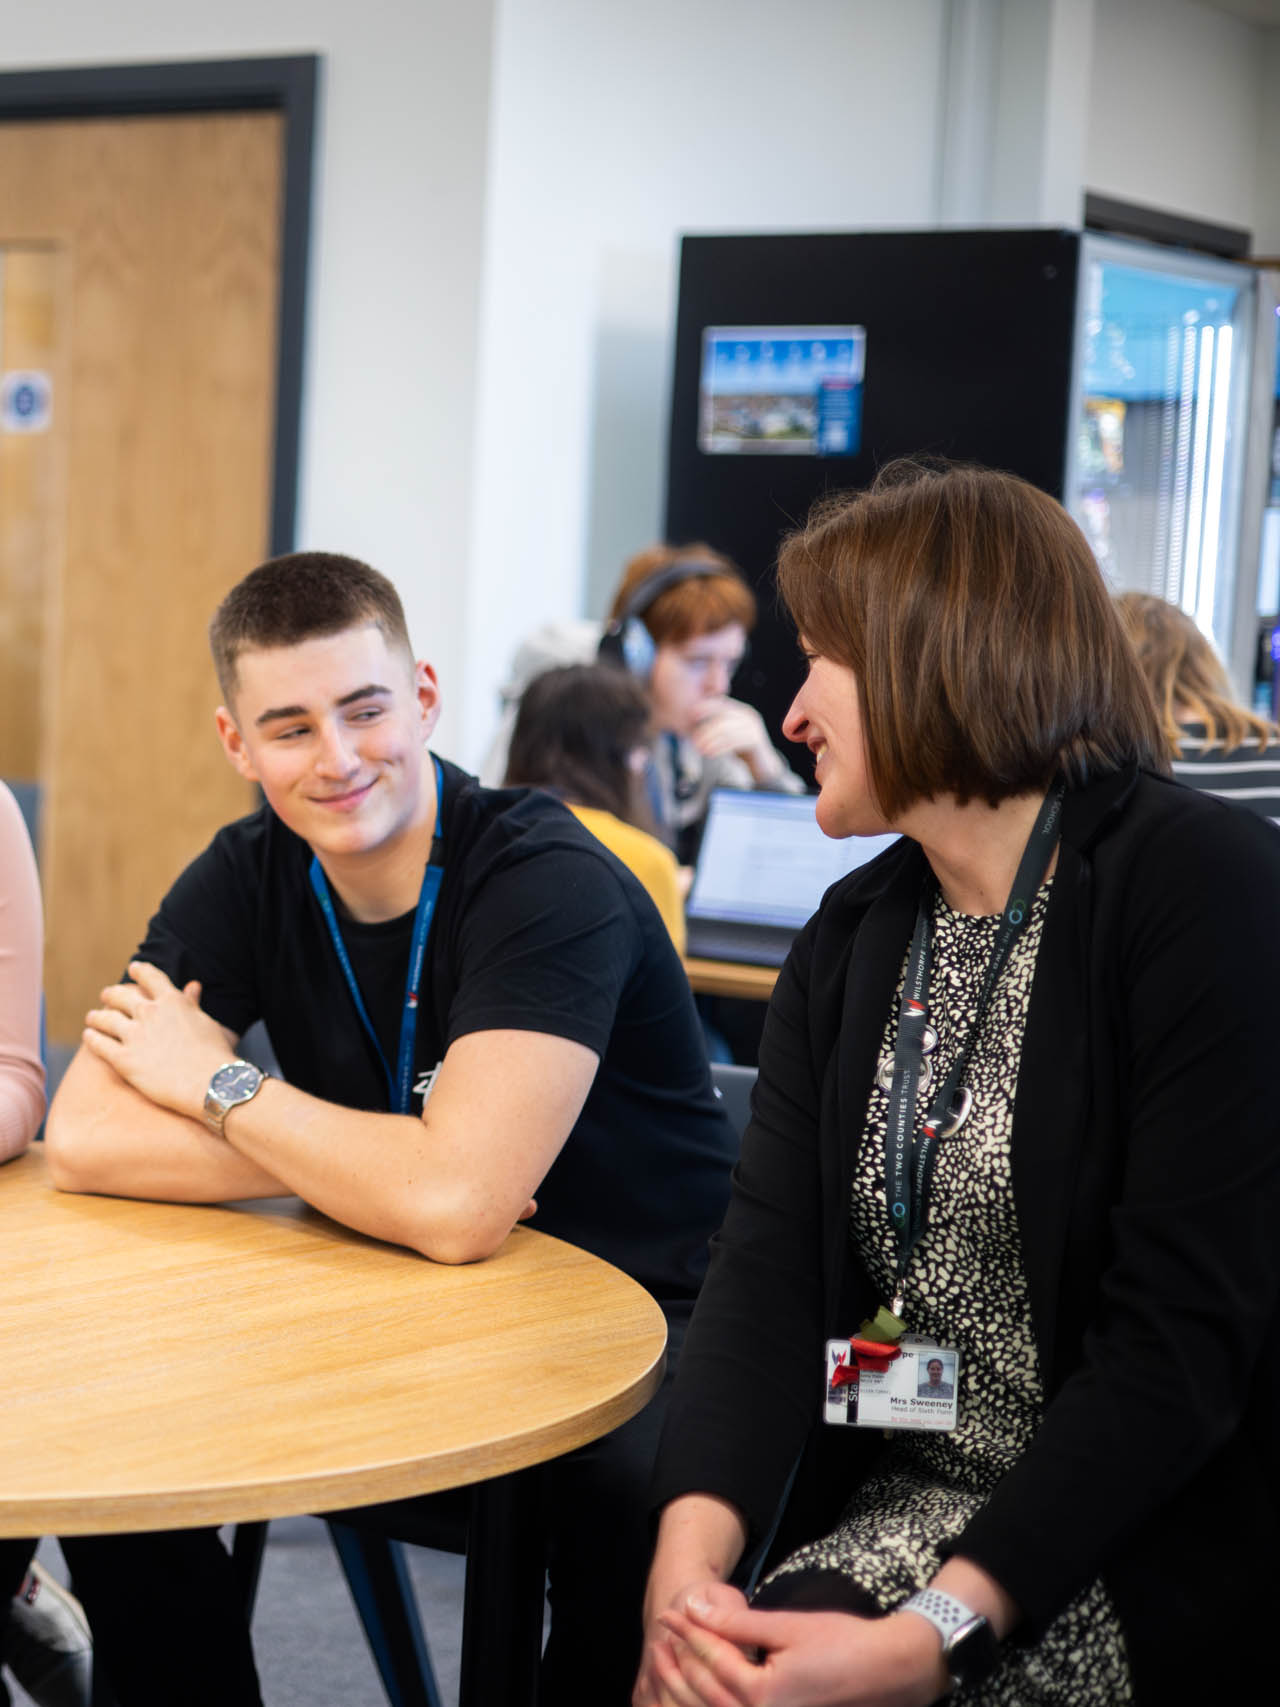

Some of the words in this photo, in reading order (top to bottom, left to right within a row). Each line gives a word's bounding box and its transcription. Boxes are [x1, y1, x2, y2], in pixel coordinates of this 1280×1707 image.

[992, 948, 1004, 970] TWO
[913, 950, 927, 1000] WILSTHORPE
[901, 1070, 911, 1094] TRUST
[897, 1098, 908, 1149] COUNTIES
[896, 1153, 904, 1176] TWO
[890, 1397, 907, 1405] Mrs
[910, 1399, 953, 1409] Sweeney
